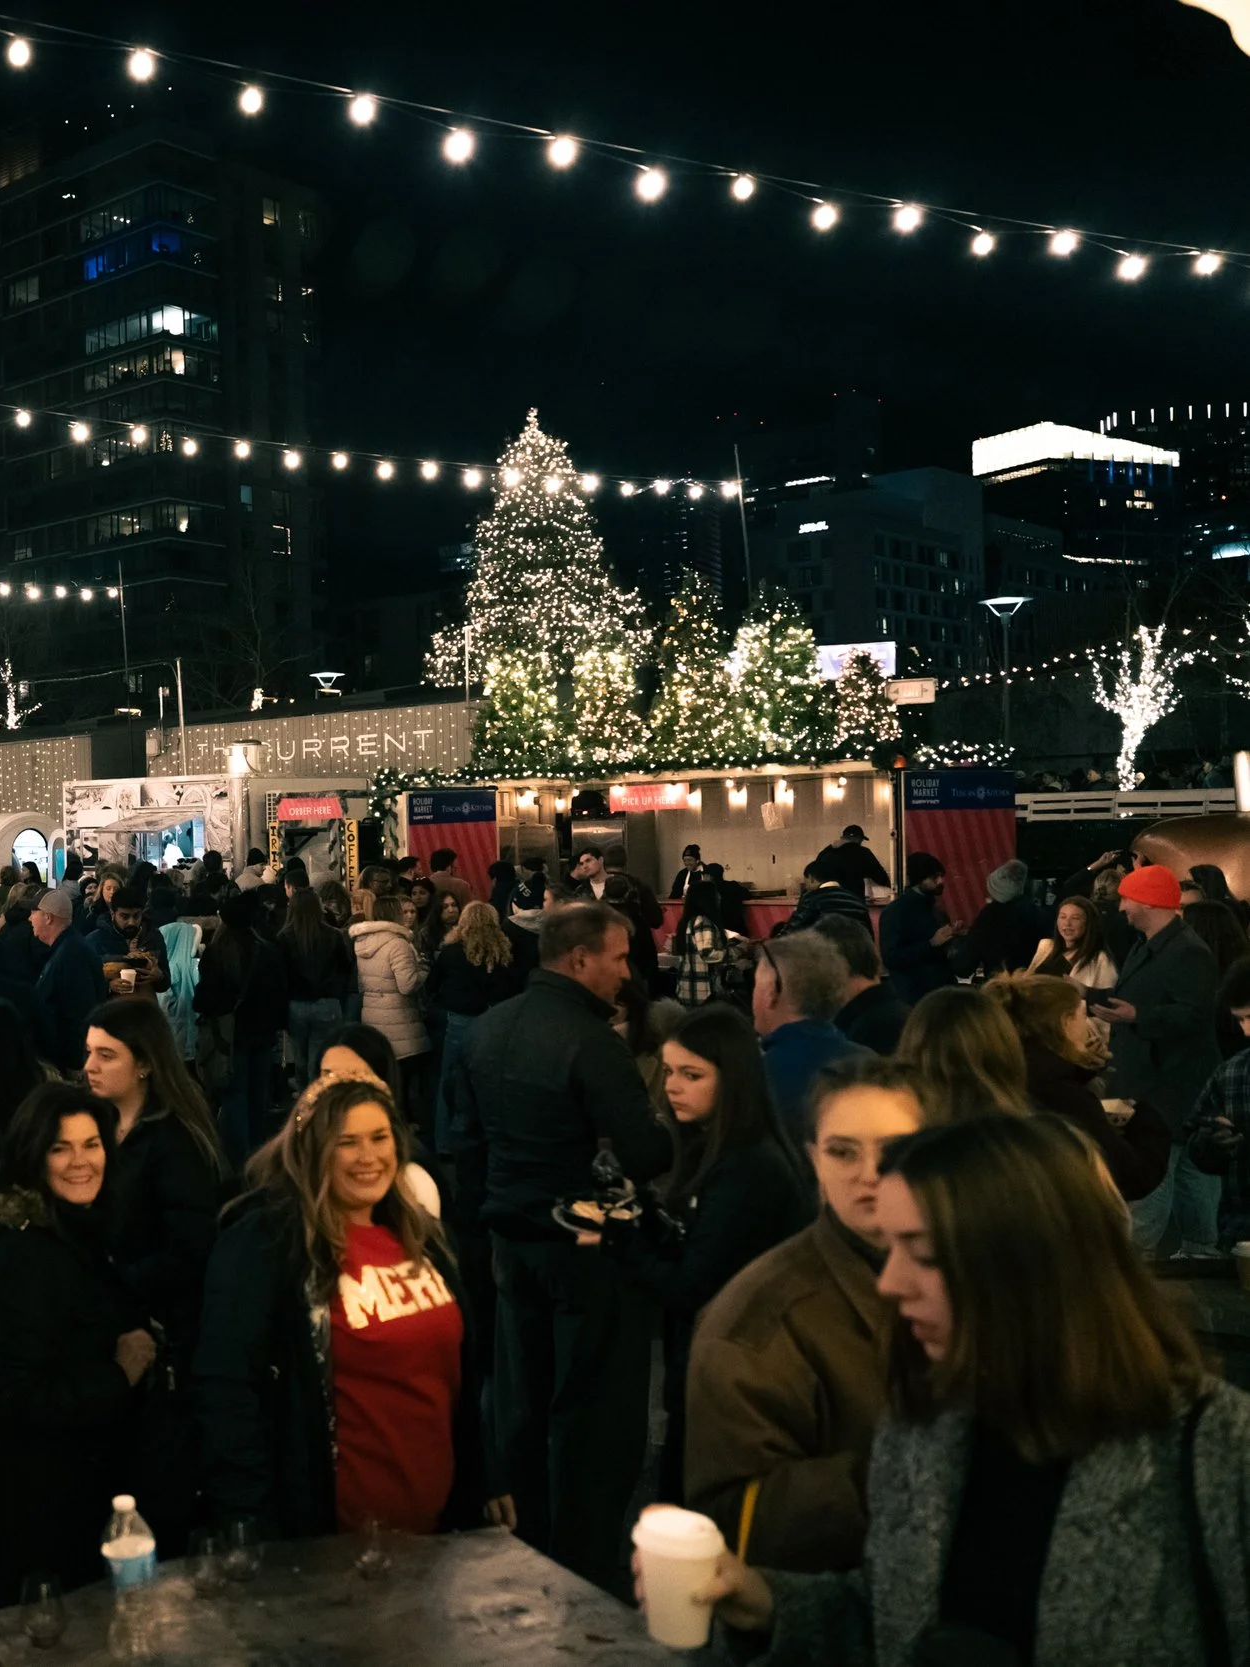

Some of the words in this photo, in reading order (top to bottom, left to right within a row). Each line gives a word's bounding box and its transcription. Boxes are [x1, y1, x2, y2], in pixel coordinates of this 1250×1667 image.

[911, 778, 940, 787] HOLIDAY
[913, 788, 938, 797] MARKET
[412, 797, 434, 805] HOLIDAY
[621, 797, 638, 807] PICK
[641, 796, 653, 806] UP
[289, 807, 312, 816] ORDER
[313, 806, 332, 815] HERE
[414, 805, 432, 814] MARKET
